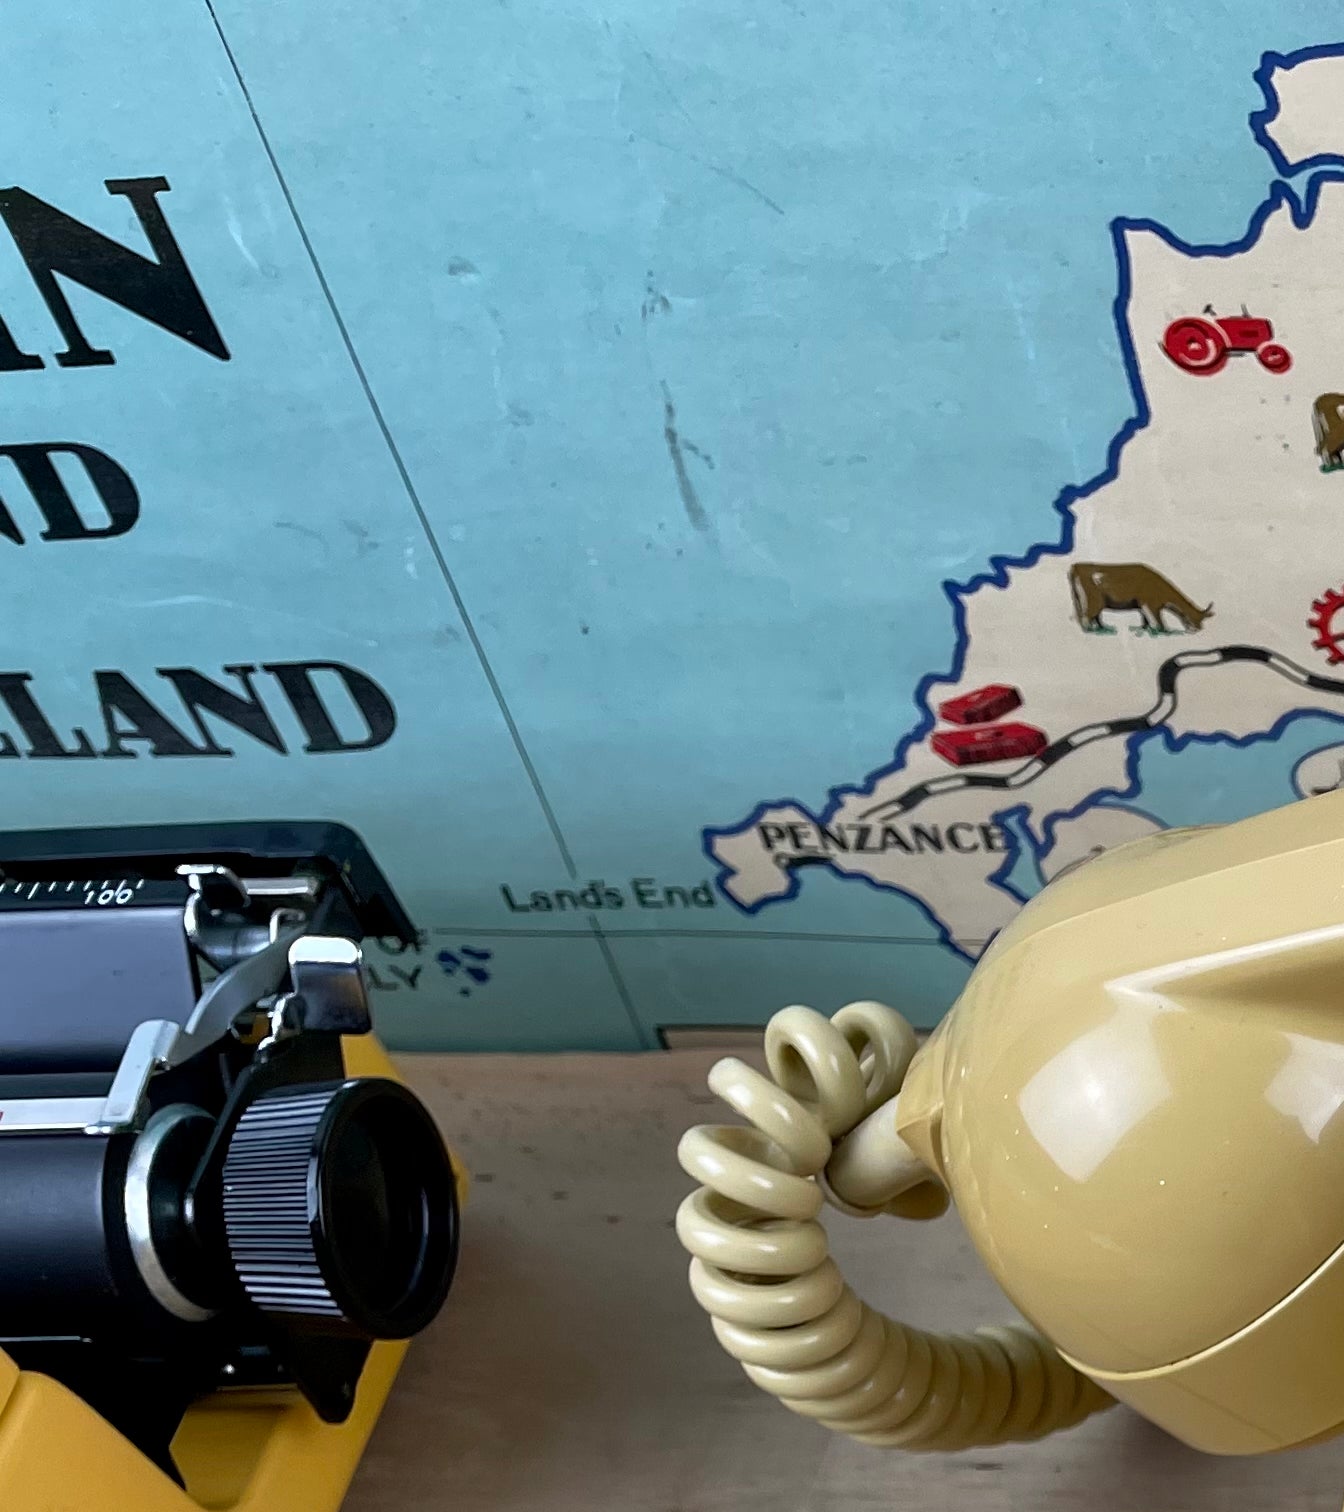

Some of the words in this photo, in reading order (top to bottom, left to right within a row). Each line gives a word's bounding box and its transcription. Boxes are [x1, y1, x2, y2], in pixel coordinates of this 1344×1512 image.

[0, 659, 397, 759] LAND
[758, 821, 1012, 856] PENZANCE
[85, 887, 134, 905] 100
[501, 879, 624, 913] Land's
[631, 877, 718, 910] End
